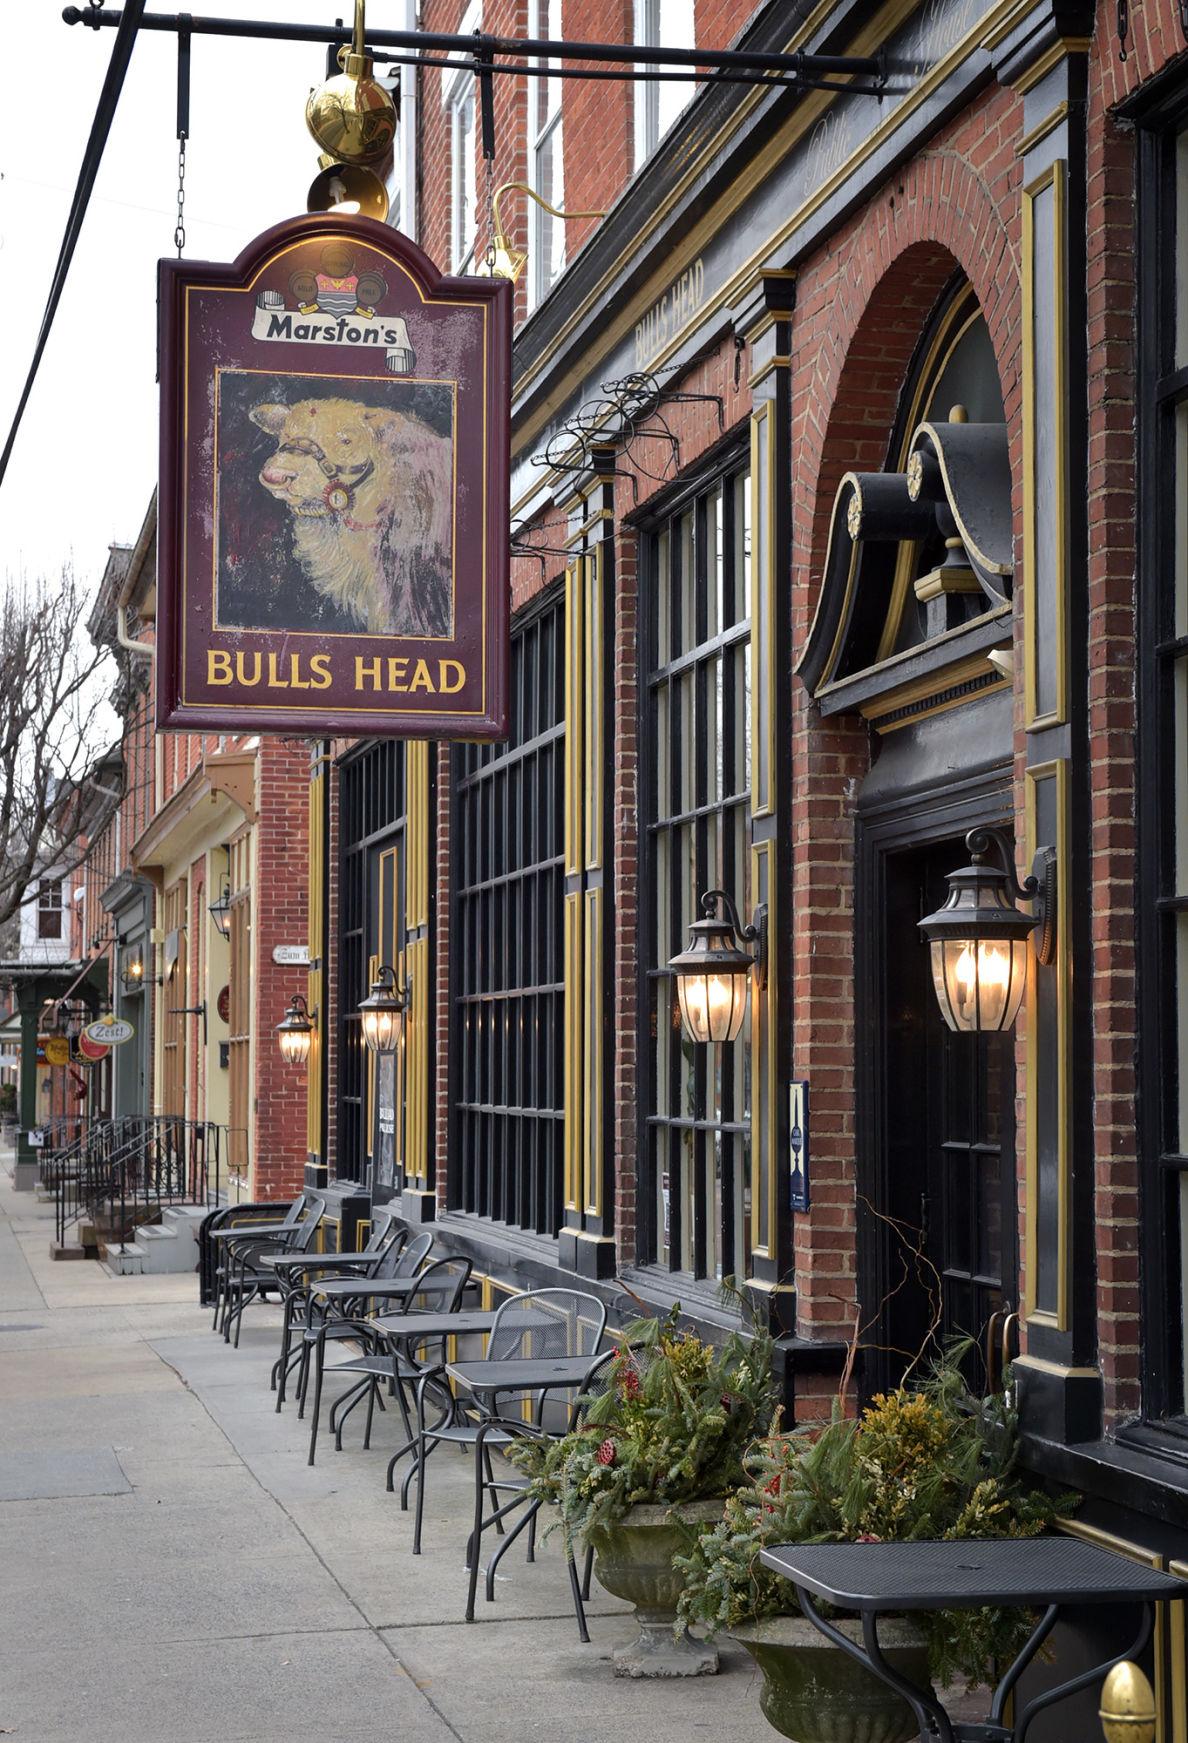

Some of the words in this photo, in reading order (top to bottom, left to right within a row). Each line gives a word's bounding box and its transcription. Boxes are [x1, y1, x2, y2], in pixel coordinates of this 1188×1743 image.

[266, 314, 398, 345] Marston's
[635, 295, 668, 370] BULLS
[672, 257, 704, 335] HEAD
[206, 649, 333, 689] BULLS
[354, 656, 466, 694] HEAD
